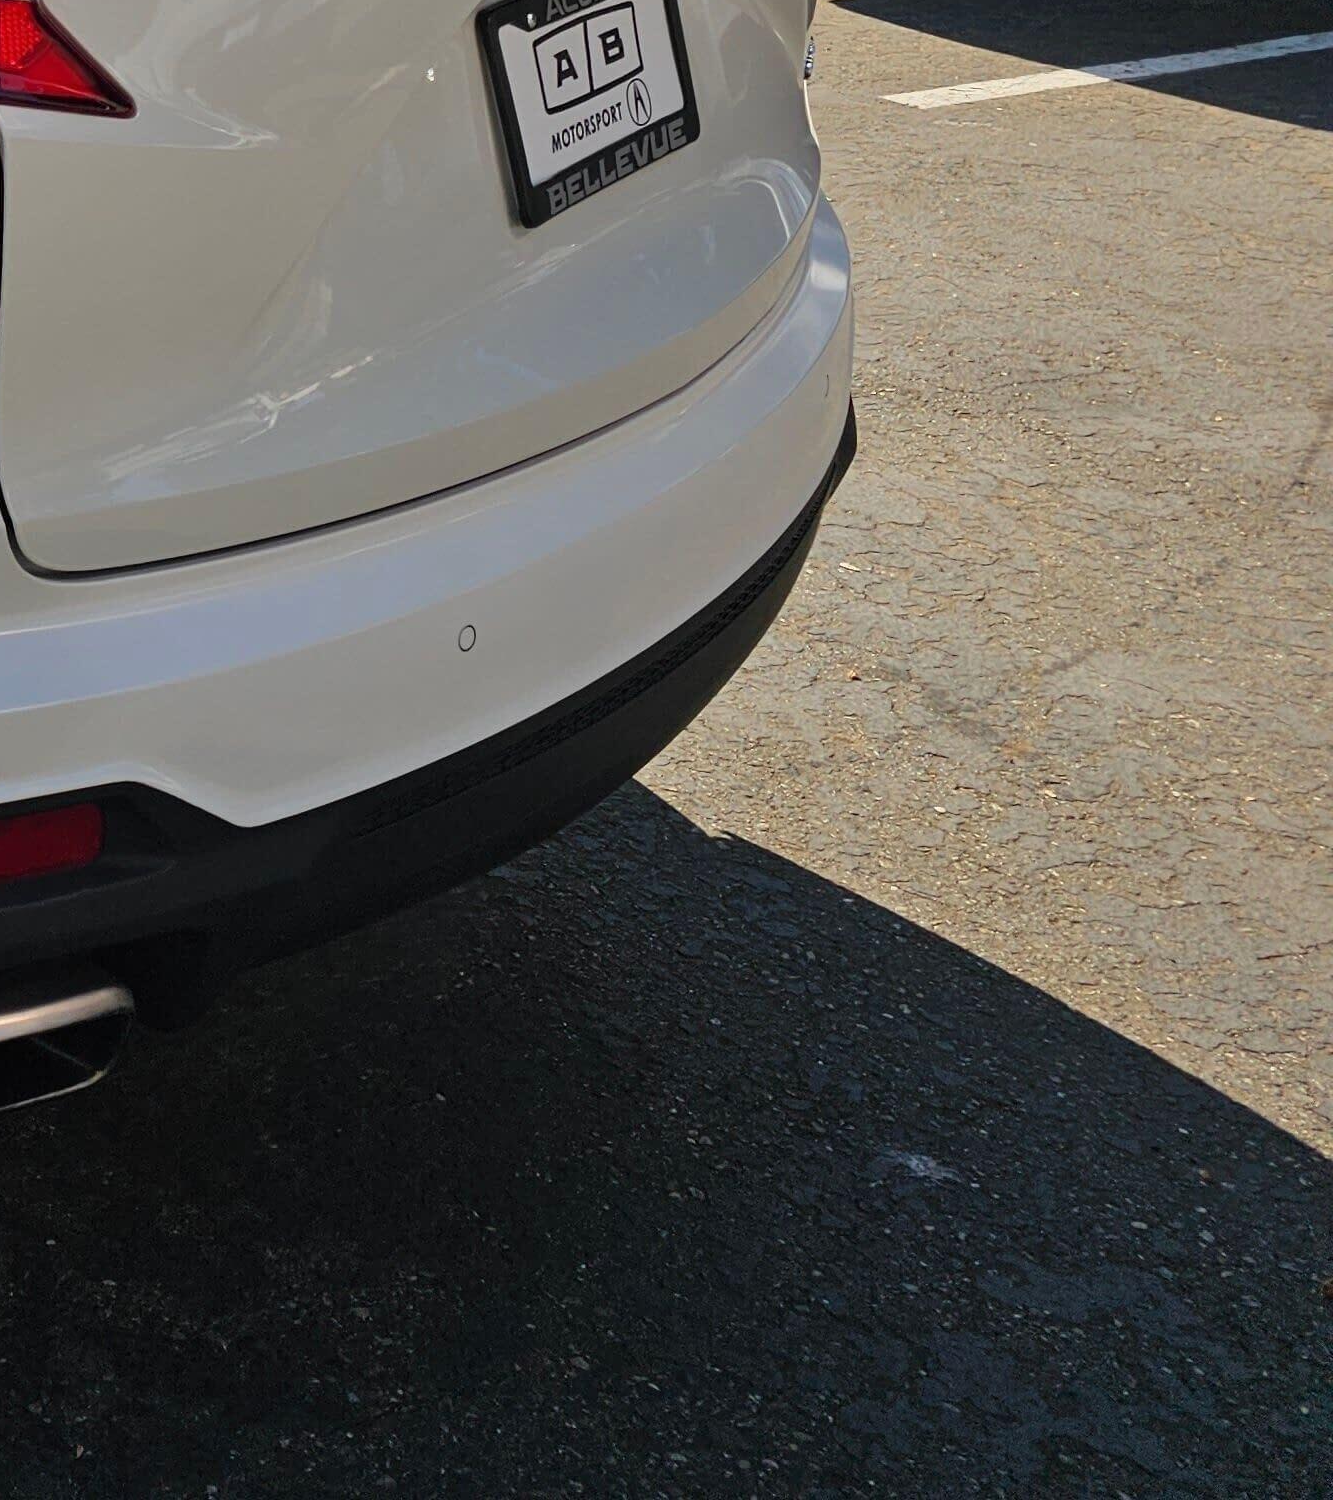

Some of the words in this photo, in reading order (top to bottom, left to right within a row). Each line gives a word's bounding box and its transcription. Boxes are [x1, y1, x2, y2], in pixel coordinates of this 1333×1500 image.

[554, 49, 579, 88] A
[597, 27, 625, 66] B
[552, 101, 623, 153] MOTORSPORT
[546, 117, 687, 215] BELLEVUE
